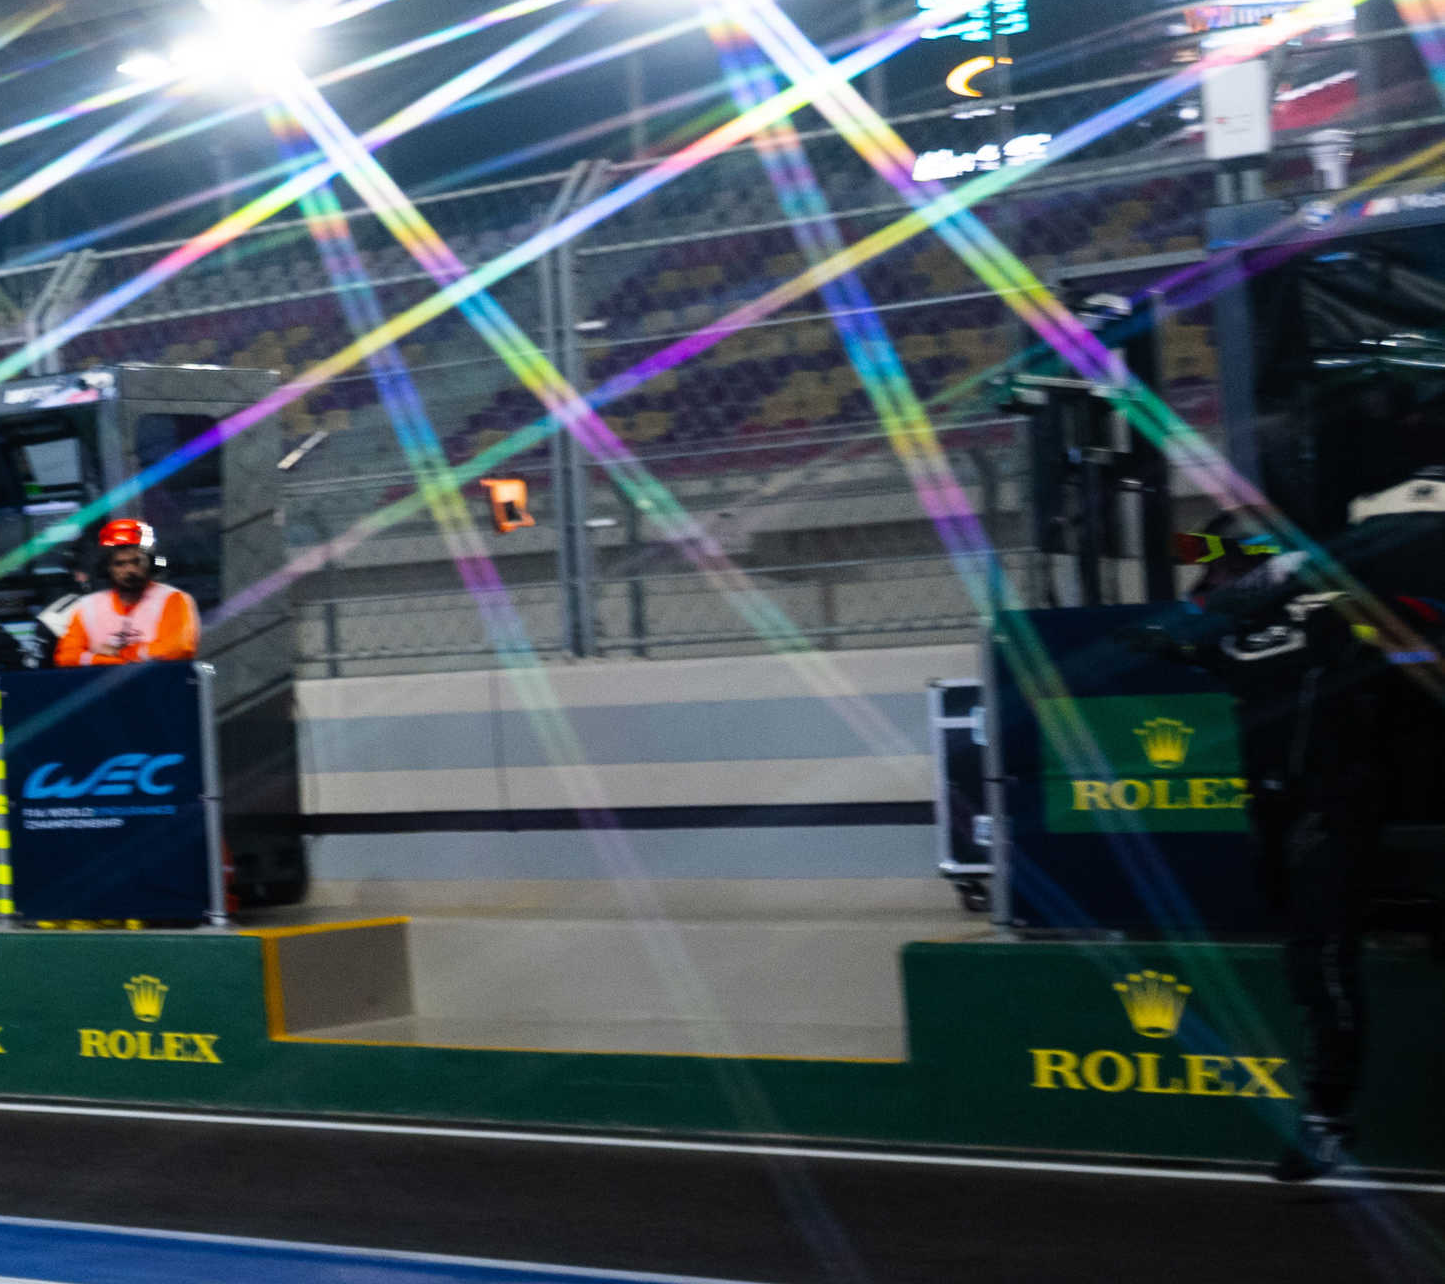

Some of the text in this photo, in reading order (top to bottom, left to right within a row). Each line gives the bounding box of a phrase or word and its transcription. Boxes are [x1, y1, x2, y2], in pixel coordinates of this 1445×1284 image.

[22, 752, 185, 800] WEC
[79, 1028, 223, 1065] ROLEX
[1029, 1049, 1296, 1100] ROLEX
